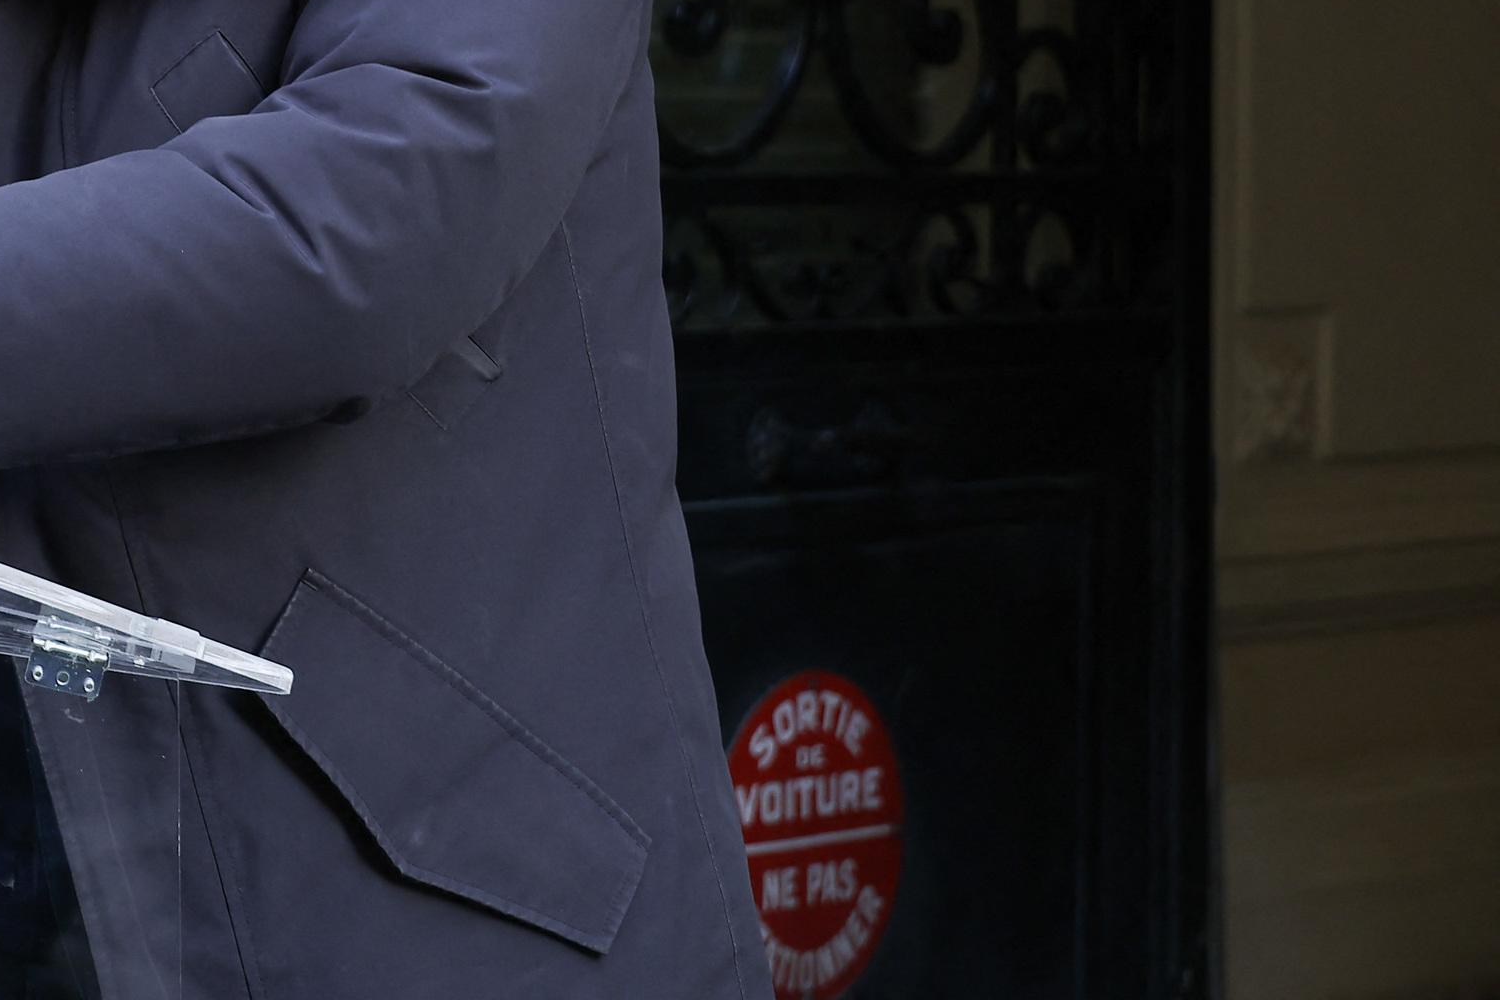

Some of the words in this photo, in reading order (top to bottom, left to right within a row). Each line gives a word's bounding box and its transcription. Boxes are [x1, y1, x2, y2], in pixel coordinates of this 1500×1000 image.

[749, 690, 870, 770] SORTIE
[795, 744, 827, 768] DE
[736, 766, 883, 826] VOITURE
[762, 866, 798, 910] NE
[806, 858, 857, 904] PAS
